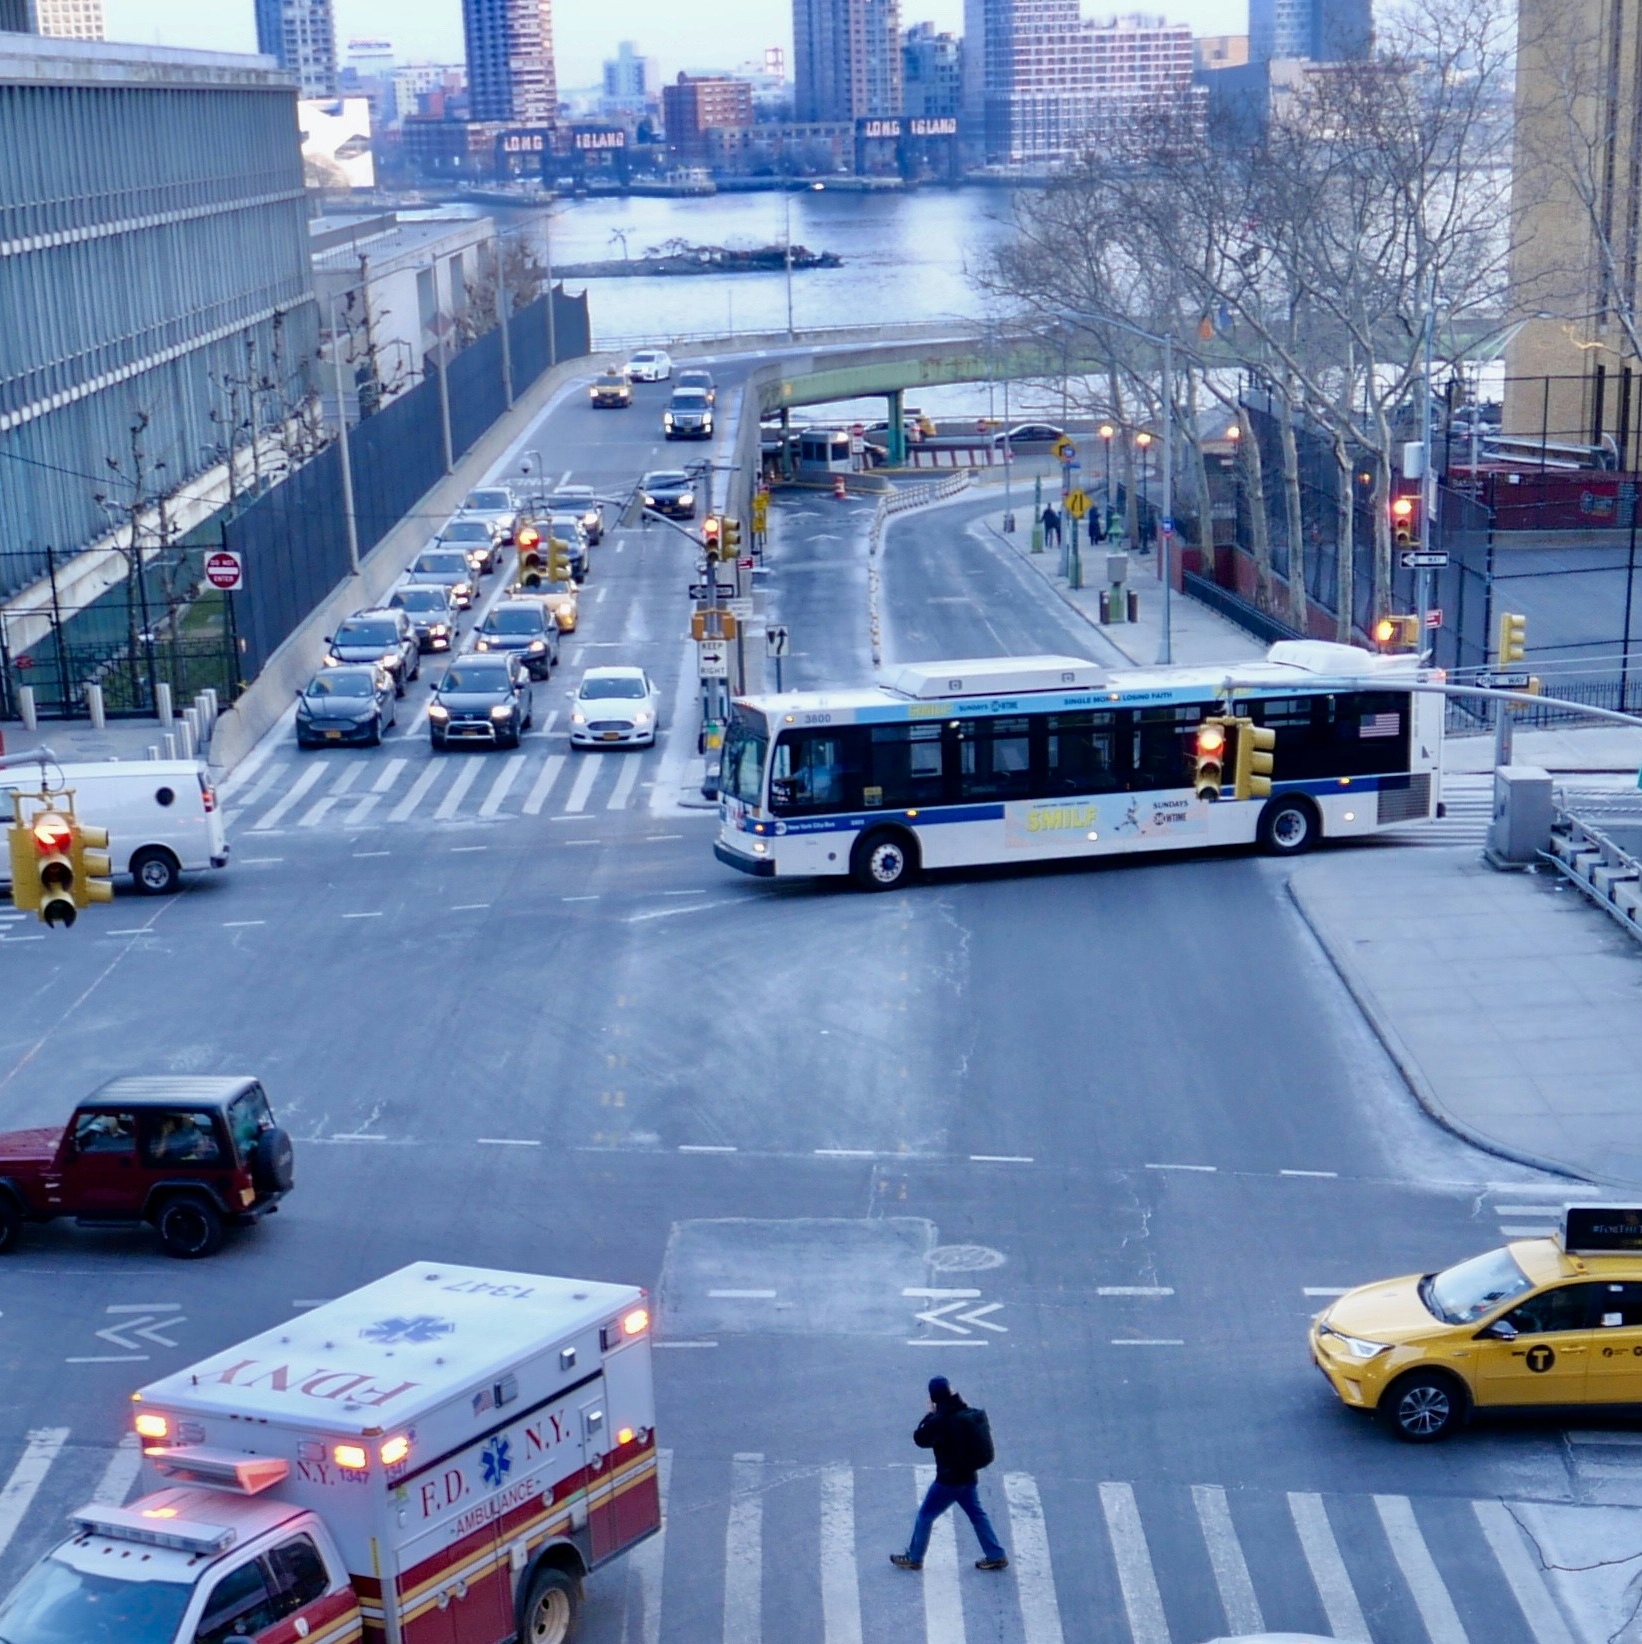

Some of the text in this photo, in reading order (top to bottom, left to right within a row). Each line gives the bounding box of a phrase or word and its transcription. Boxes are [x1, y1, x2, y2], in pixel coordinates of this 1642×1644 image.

[866, 118, 956, 136] LONG ISLAND
[702, 642, 723, 650] KEEP
[700, 666, 725, 675] RIGHT
[1481, 674, 1525, 685] ONE WAY
[1064, 697, 1091, 705] SINGLE
[804, 714, 831, 724] 3800
[1153, 800, 1189, 809] SUNDAYS
[1026, 806, 1098, 832] SMILF
[441, 1279, 536, 1300] 1347
[197, 1359, 422, 1407] FDNY
[419, 1408, 571, 1520] F.D. N.Y.
[297, 1460, 371, 1486] N.Y. 1347
